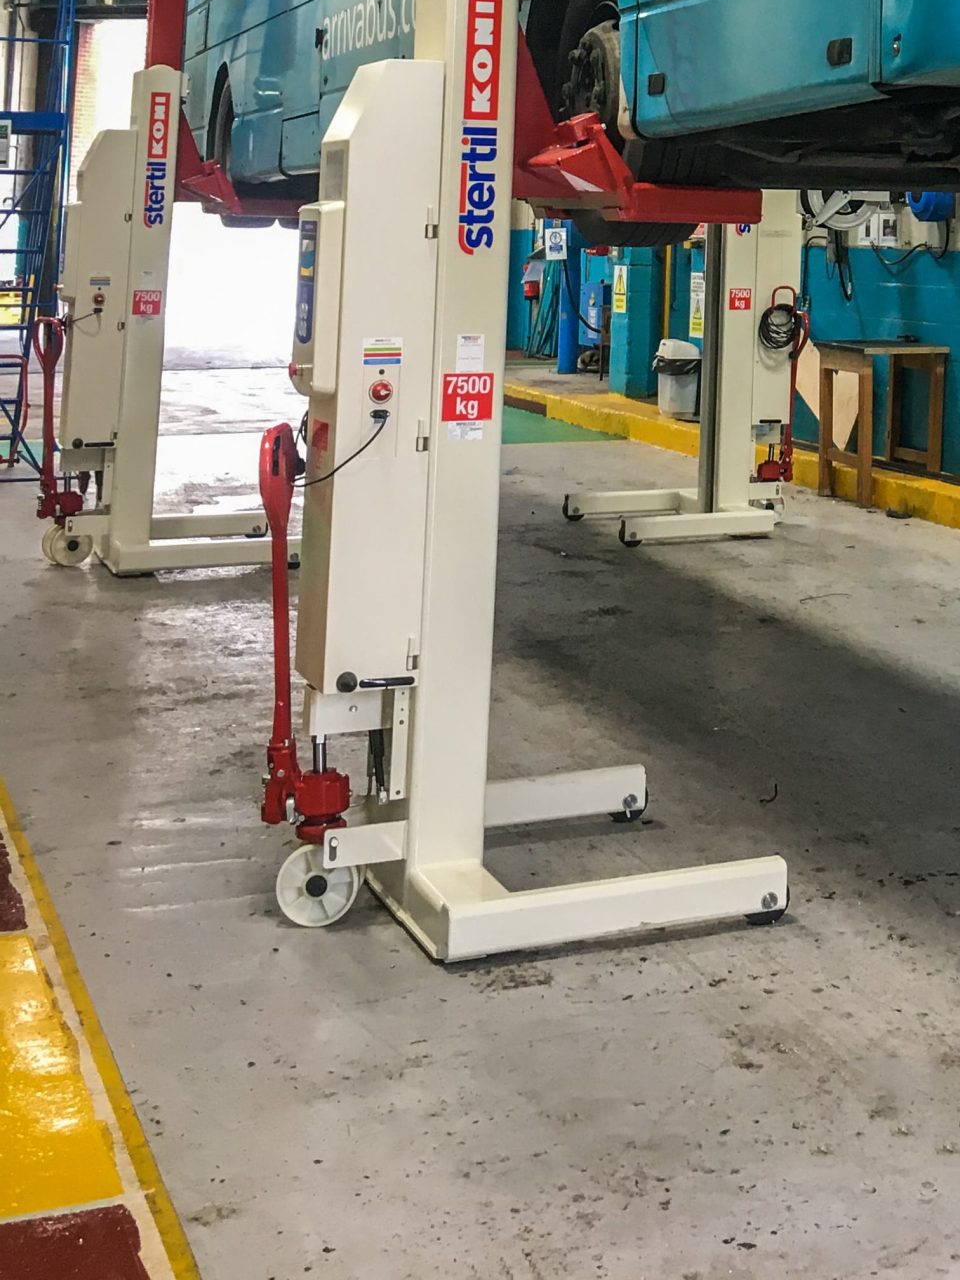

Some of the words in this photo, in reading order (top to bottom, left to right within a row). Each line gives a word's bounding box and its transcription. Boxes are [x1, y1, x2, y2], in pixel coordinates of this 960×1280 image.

[471, 1, 495, 113] KONI
[151, 96, 167, 155] KONI
[144, 161, 167, 227] stertil
[459, 126, 498, 253] stertil
[134, 291, 160, 302] 7500
[730, 289, 751, 298] 7500
[140, 302, 153, 313] kg
[735, 299, 745, 309] kg
[446, 376, 491, 394] 7500
[455, 397, 479, 419] kg
